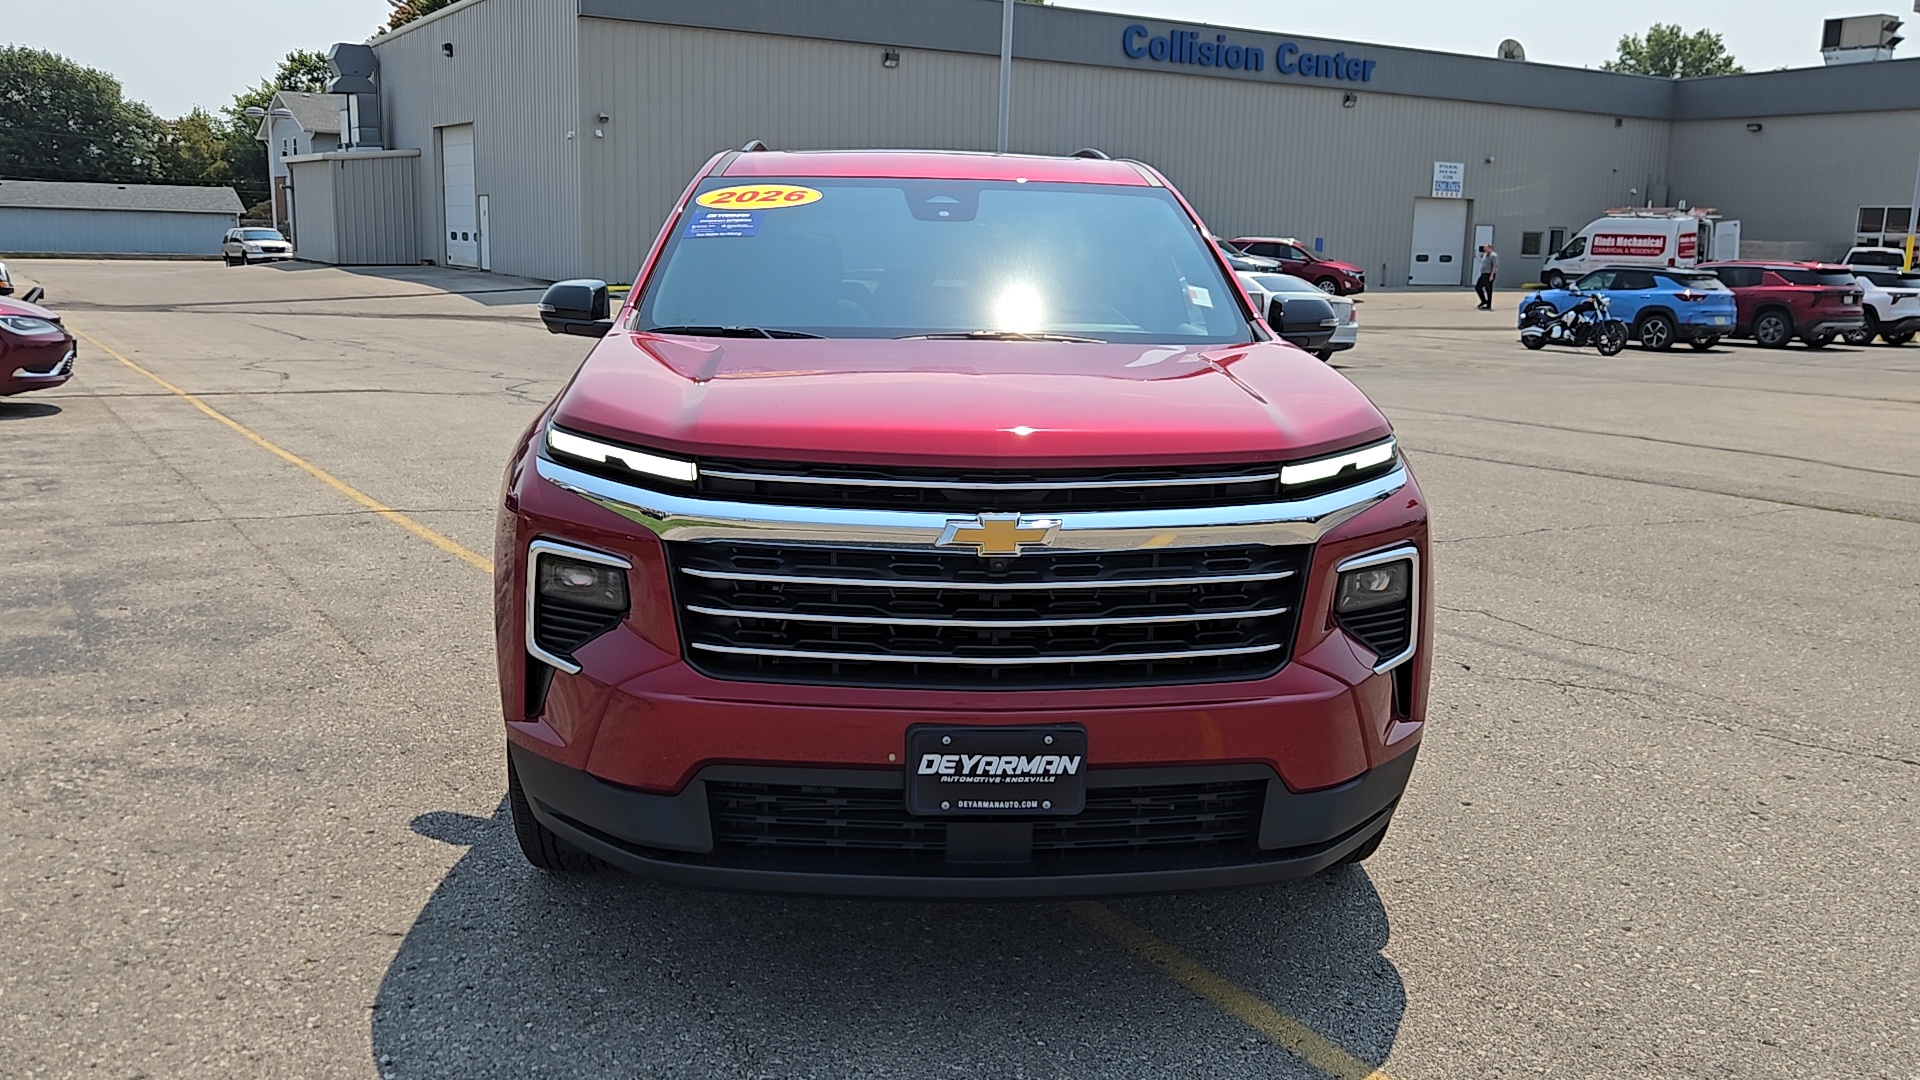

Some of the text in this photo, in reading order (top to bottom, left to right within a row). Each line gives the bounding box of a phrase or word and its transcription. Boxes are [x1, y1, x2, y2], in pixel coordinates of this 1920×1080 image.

[1123, 24, 1376, 82] Collision Center
[709, 190, 808, 204] 2026
[1616, 236, 1664, 248] Mechanical
[917, 753, 1082, 775] DEYARMAN
